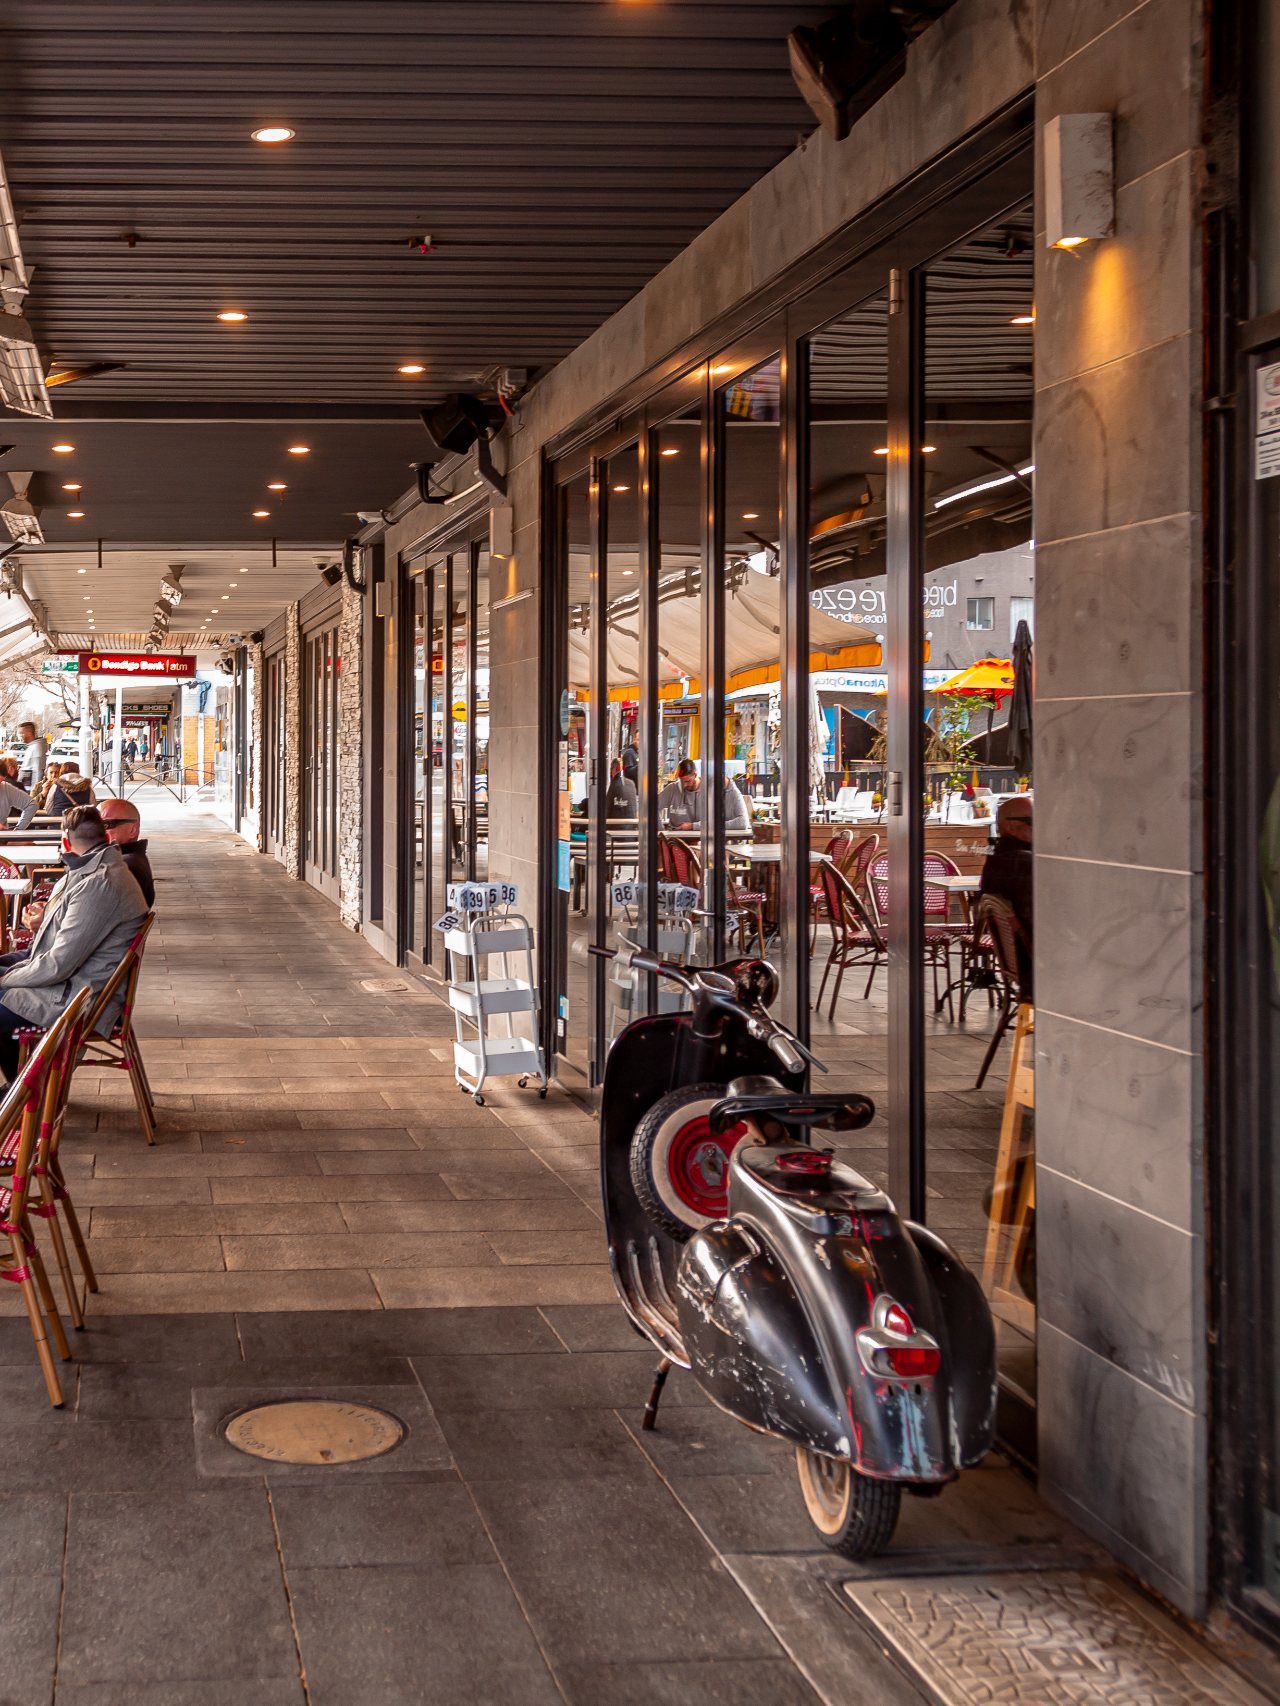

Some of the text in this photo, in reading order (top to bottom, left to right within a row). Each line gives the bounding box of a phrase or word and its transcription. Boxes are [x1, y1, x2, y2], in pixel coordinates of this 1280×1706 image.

[102, 659, 188, 671] Bendigo Bank atm
[469, 892, 483, 908] 39
[501, 885, 516, 903] 36
[438, 916, 459, 930] 30
